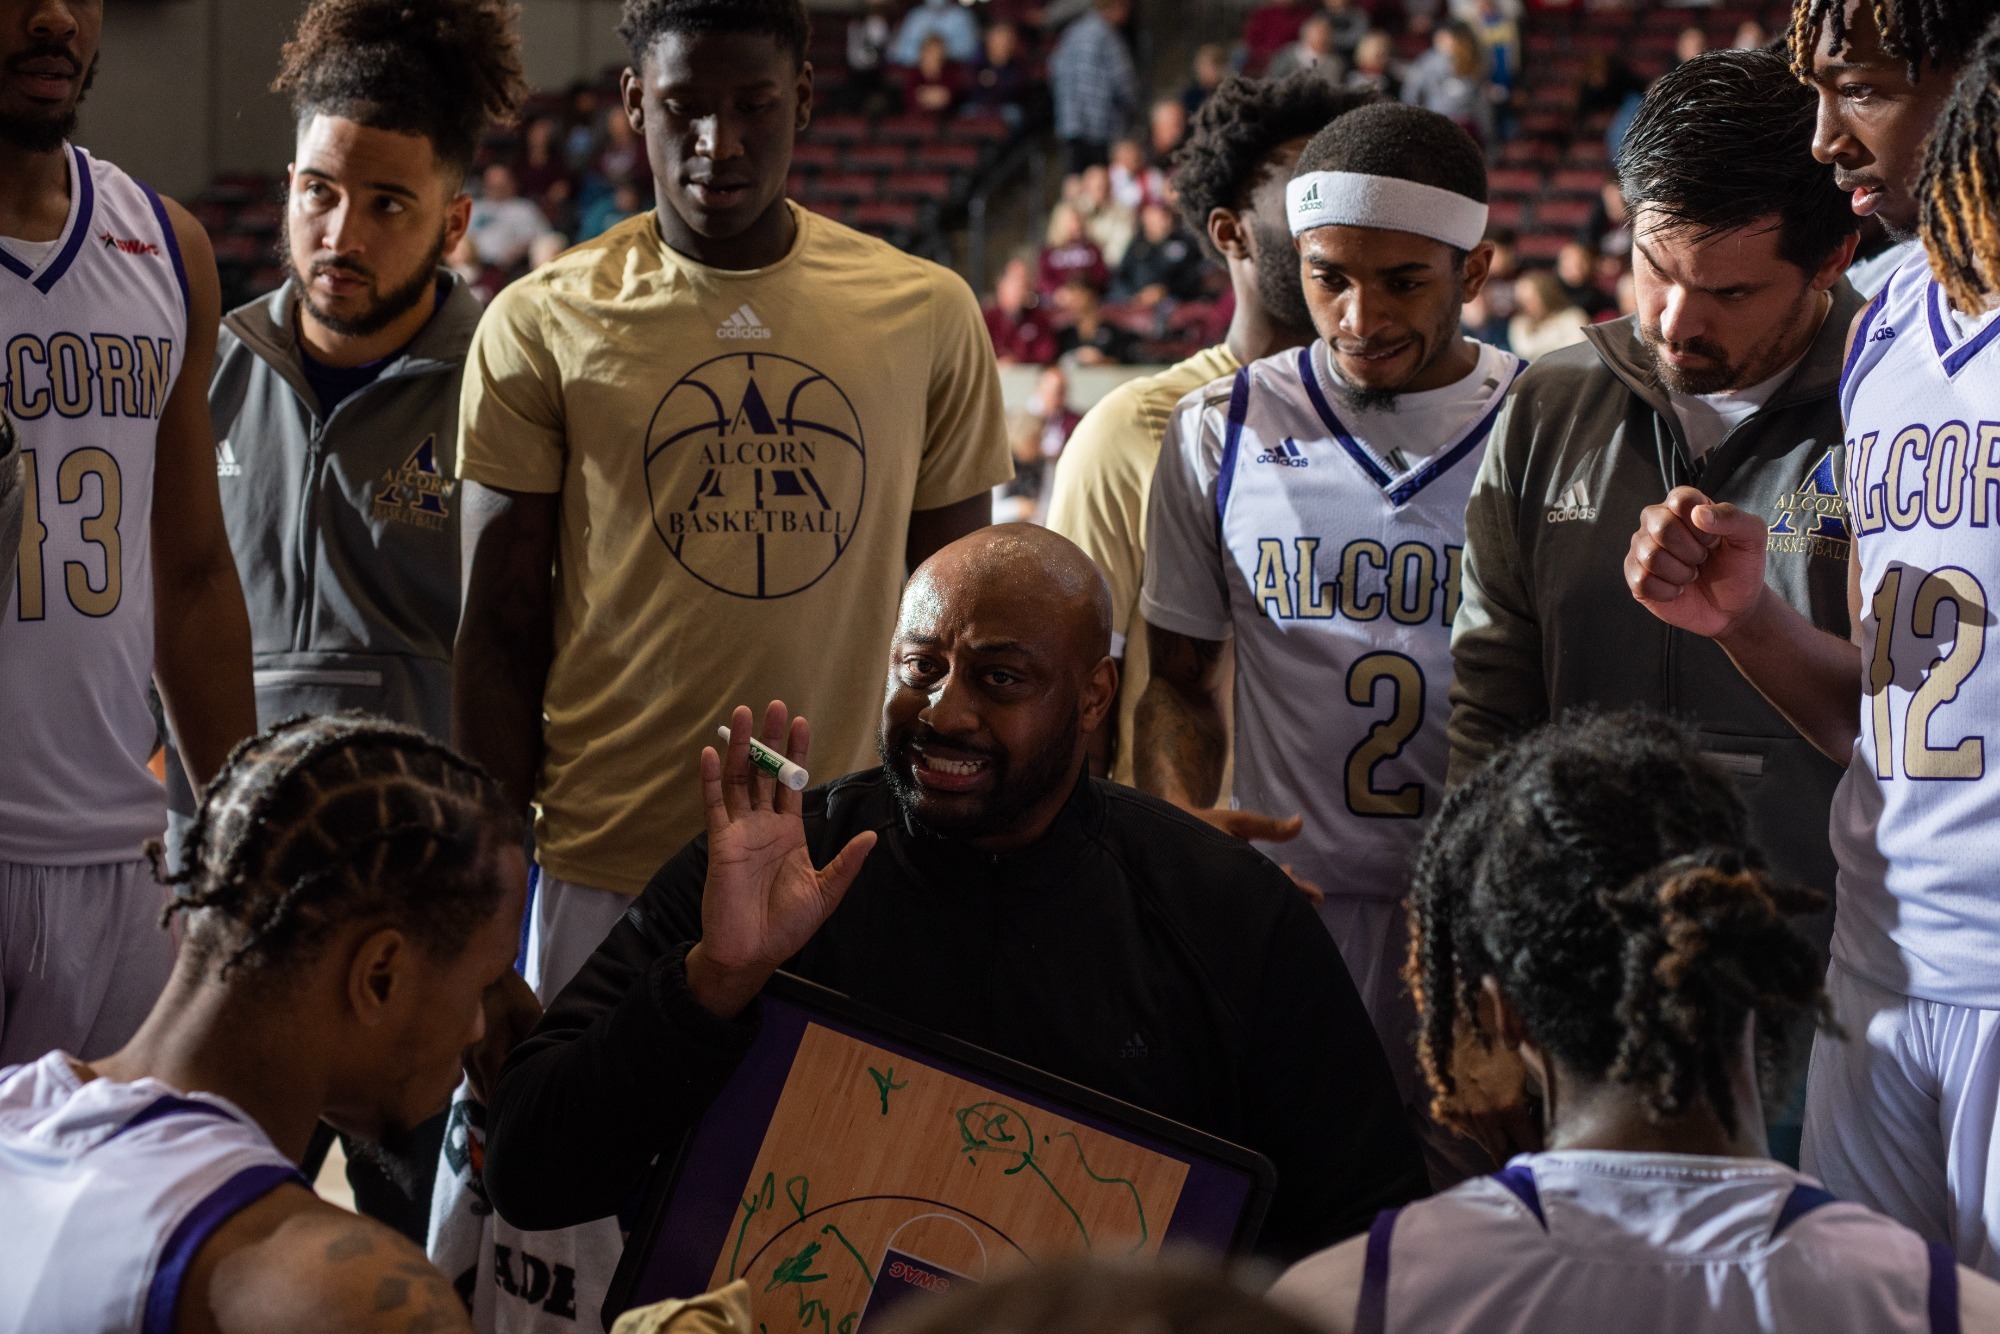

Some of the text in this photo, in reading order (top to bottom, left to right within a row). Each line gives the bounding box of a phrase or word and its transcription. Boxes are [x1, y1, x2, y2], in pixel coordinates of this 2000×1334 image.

[716, 325, 772, 339] adidas
[0, 332, 171, 420] CORN
[698, 441, 817, 465] ALCORN
[1257, 454, 1309, 468] adidas
[1547, 505, 1596, 523] adidas
[1774, 494, 1847, 516] ALCOR
[16, 446, 122, 621] 13
[669, 510, 847, 534] BASKETBALL
[1870, 565, 1988, 781] 12
[1344, 650, 1426, 819] 2
[889, 1261, 949, 1293] SWAC
